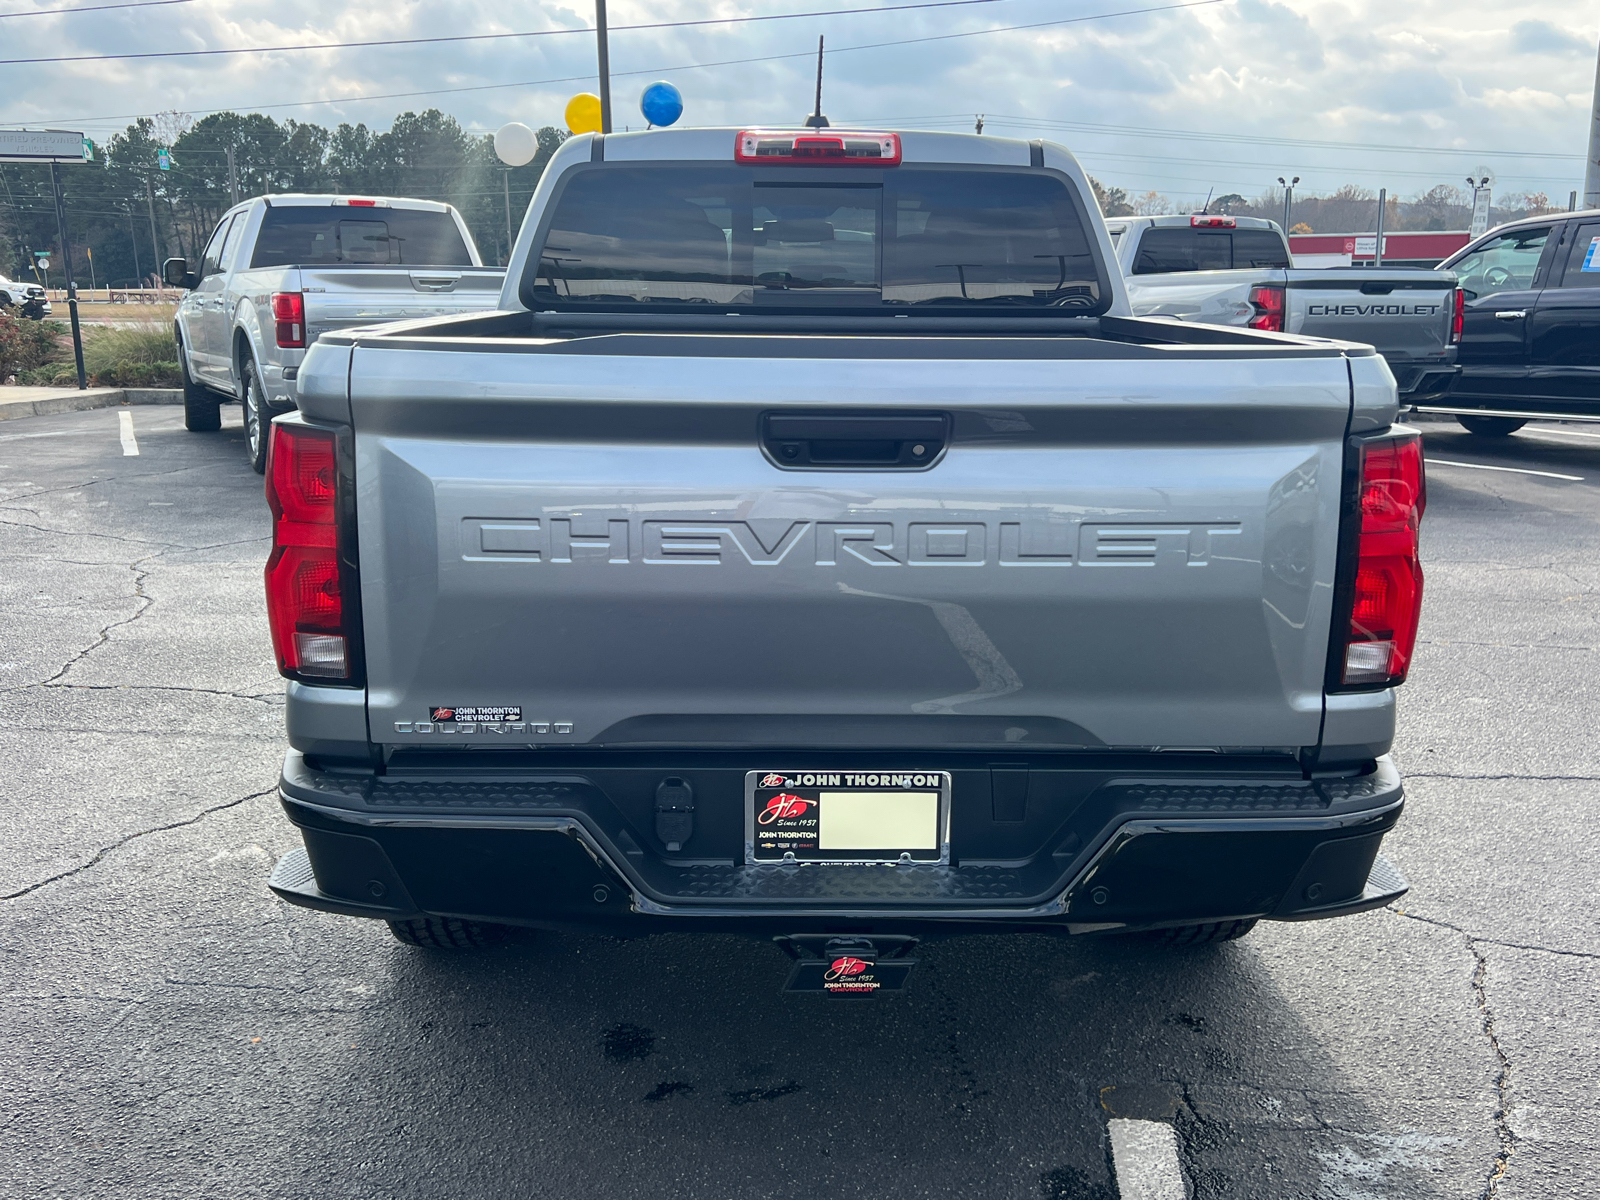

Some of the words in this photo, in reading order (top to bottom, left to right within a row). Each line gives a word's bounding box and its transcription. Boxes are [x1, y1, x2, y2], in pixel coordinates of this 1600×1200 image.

[1308, 304, 1441, 316] CHEVROLET
[460, 516, 1243, 569] CHEVROLET
[455, 707, 476, 715] JOHN
[394, 721, 575, 734] COLORADO
[794, 774, 841, 787] JOHN
[845, 774, 940, 788] THORNTON
[776, 819, 797, 827] Since
[798, 819, 817, 827] 1957
[758, 831, 777, 839] JOHN
[777, 831, 817, 839] THORNTON
[858, 974, 875, 982] 1957
